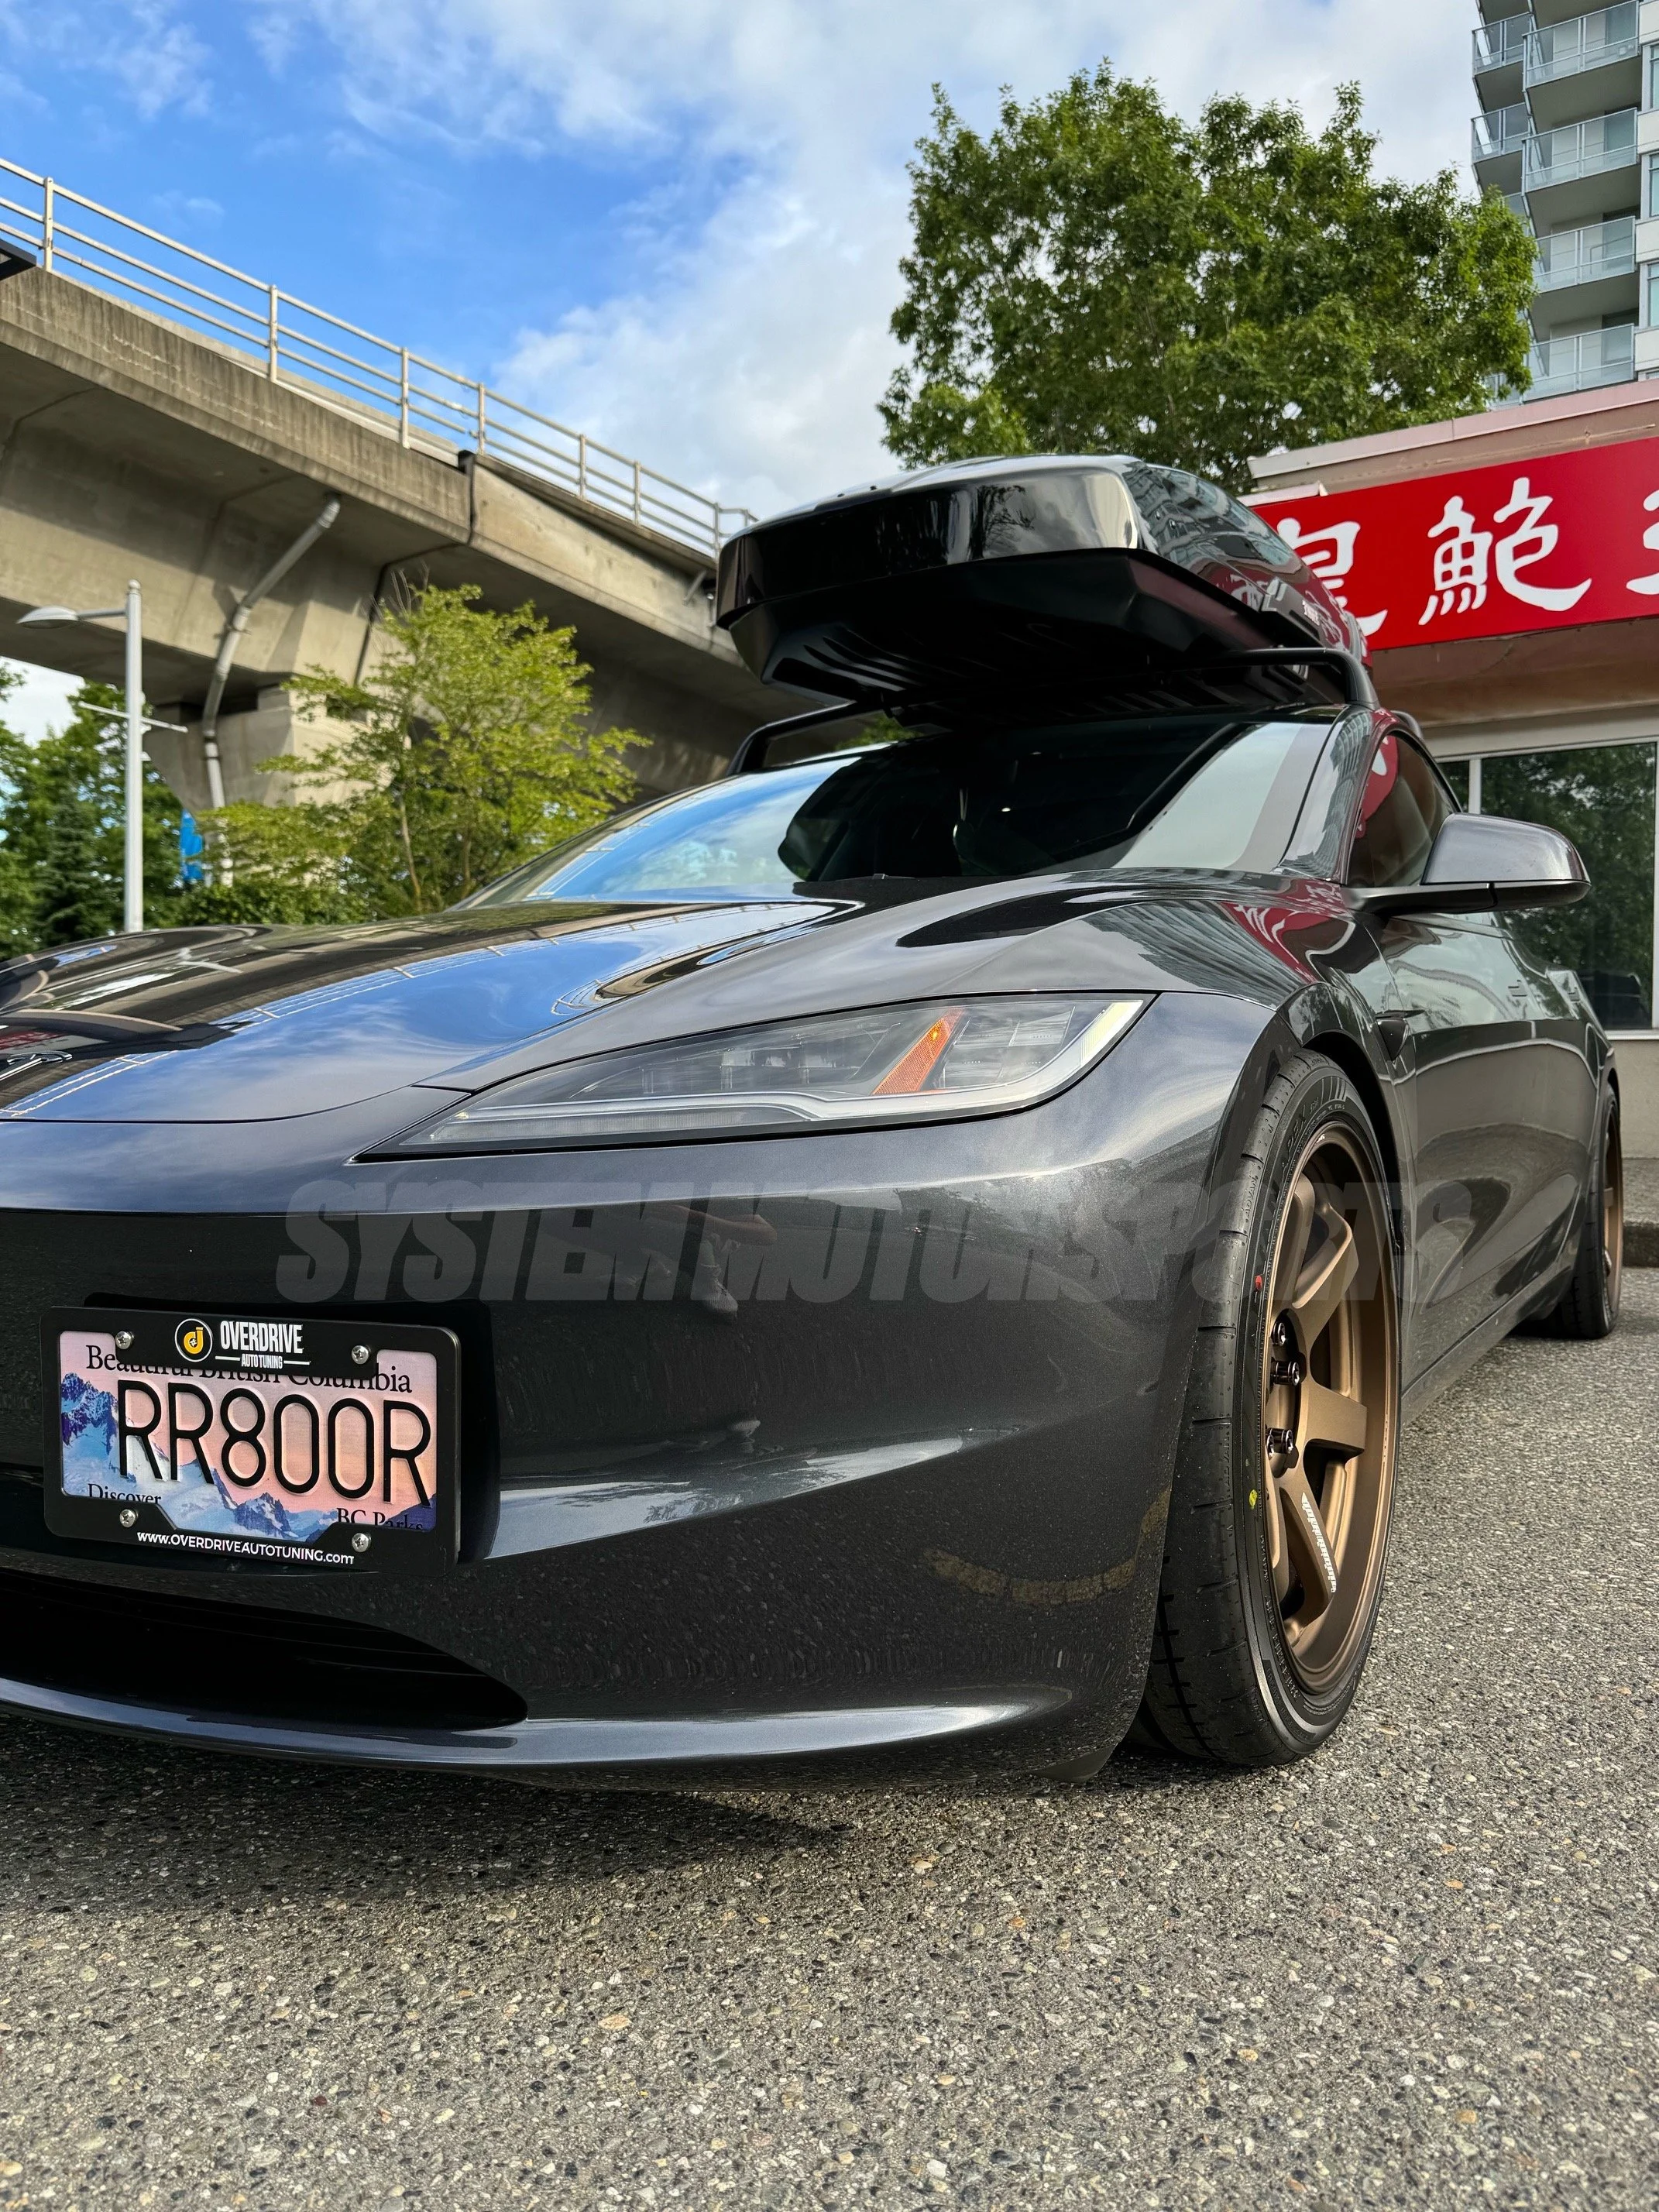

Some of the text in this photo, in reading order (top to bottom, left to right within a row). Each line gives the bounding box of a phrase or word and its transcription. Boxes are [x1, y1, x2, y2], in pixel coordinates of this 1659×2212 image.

[219, 1320, 304, 1354] OVERDRIVE
[117, 1379, 431, 1507] RR800R
[137, 1531, 355, 1565] www.OVERDRIVEAUTOTUNING.com
